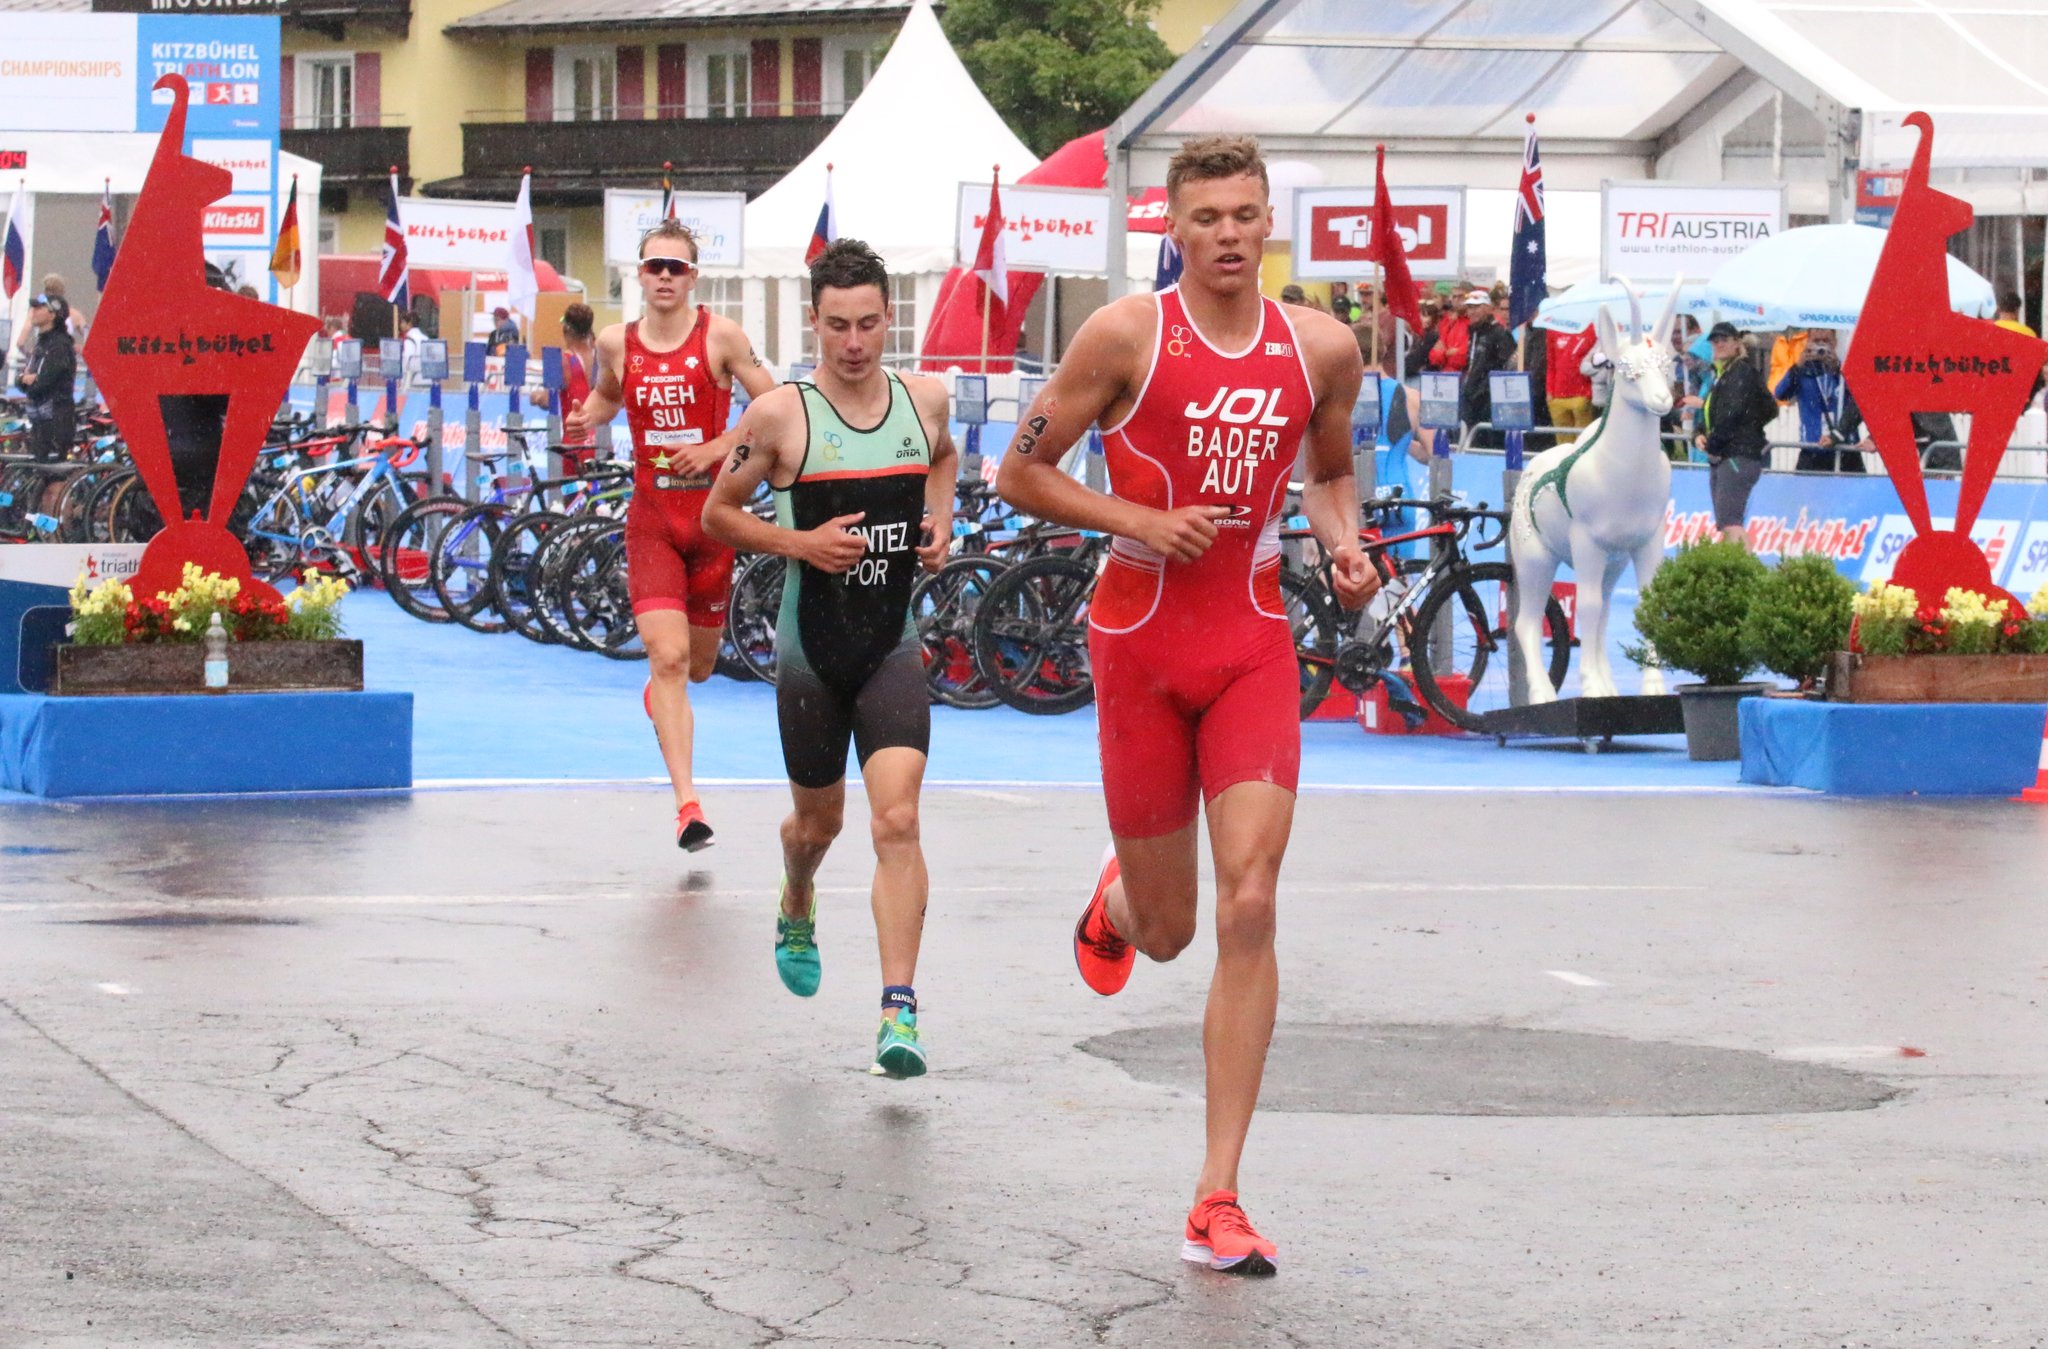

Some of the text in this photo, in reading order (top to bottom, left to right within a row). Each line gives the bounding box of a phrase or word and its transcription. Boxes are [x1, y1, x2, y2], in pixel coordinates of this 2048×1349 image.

[152, 40, 259, 60] KITZBÜHEL
[1, 60, 122, 78] CHAMPIONSHIPS
[153, 61, 260, 79] TRIATHLON
[203, 212, 260, 228] KitzSki
[1617, 212, 1770, 239] TRI AUSTRIA
[1328, 214, 1432, 253] Tiol
[636, 385, 696, 406] FAEH
[1184, 386, 1290, 427] JOL
[652, 407, 686, 428] SUI
[896, 448, 921, 459] ONDA
[1187, 426, 1279, 461] BADER
[1200, 459, 1258, 495] AUT
[1213, 518, 1251, 526] BORN
[841, 522, 909, 553] NTEZ
[101, 558, 140, 574] triath
[845, 559, 889, 586] POR
